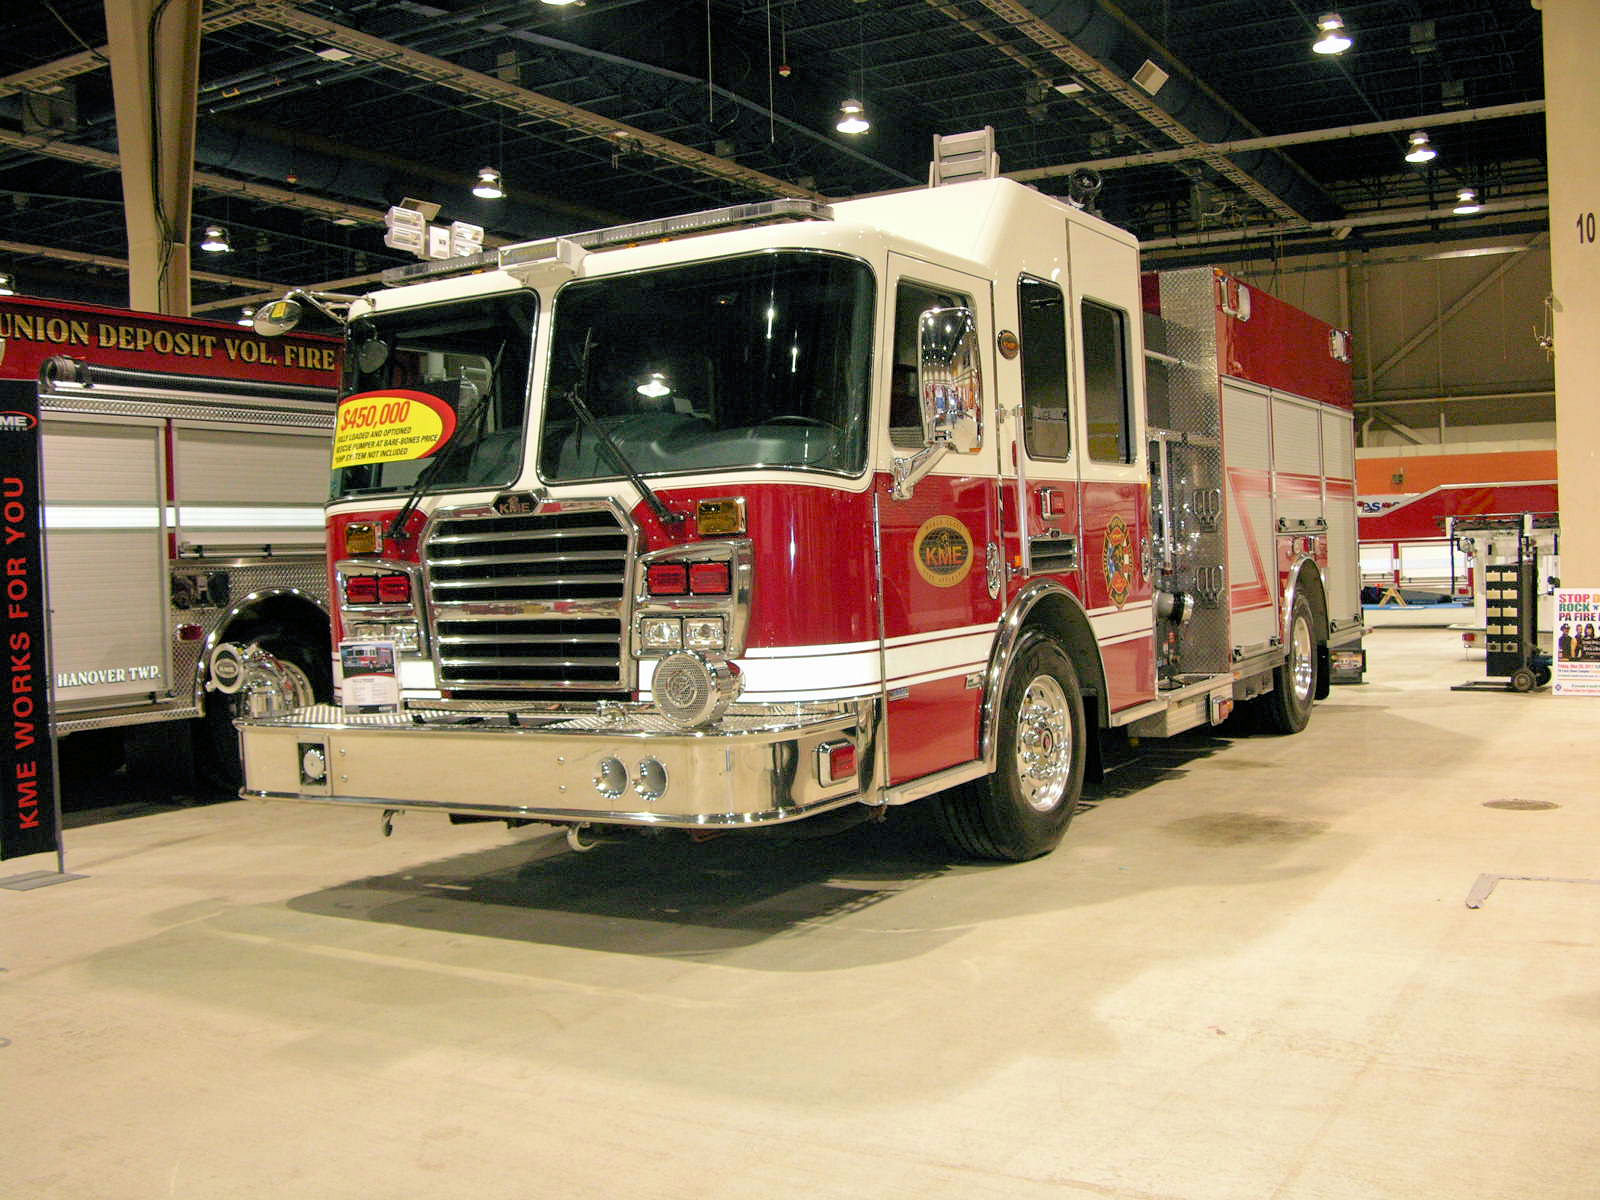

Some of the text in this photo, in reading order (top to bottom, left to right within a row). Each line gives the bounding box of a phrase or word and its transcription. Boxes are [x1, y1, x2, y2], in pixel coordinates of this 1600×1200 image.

[1576, 212, 1596, 244] 10
[0, 313, 336, 371] UNION DEPOSIT VOL. FIRE
[341, 400, 411, 431] $450,000
[370, 430, 383, 438] AND
[384, 426, 412, 437] OPTIONED
[384, 436, 421, 447] BARE-BONES
[421, 433, 439, 443] PRICE
[368, 449, 380, 458] NOT
[380, 447, 409, 457] INCLUDED
[925, 545, 963, 566] KME
[1558, 593, 1590, 603] STOP
[1558, 603, 1590, 612] ROCK
[1558, 612, 1596, 621] PA FIRE
[3, 477, 40, 829] KME WORKS FOR YOU
[57, 665, 161, 689] HANOVER TWP.
